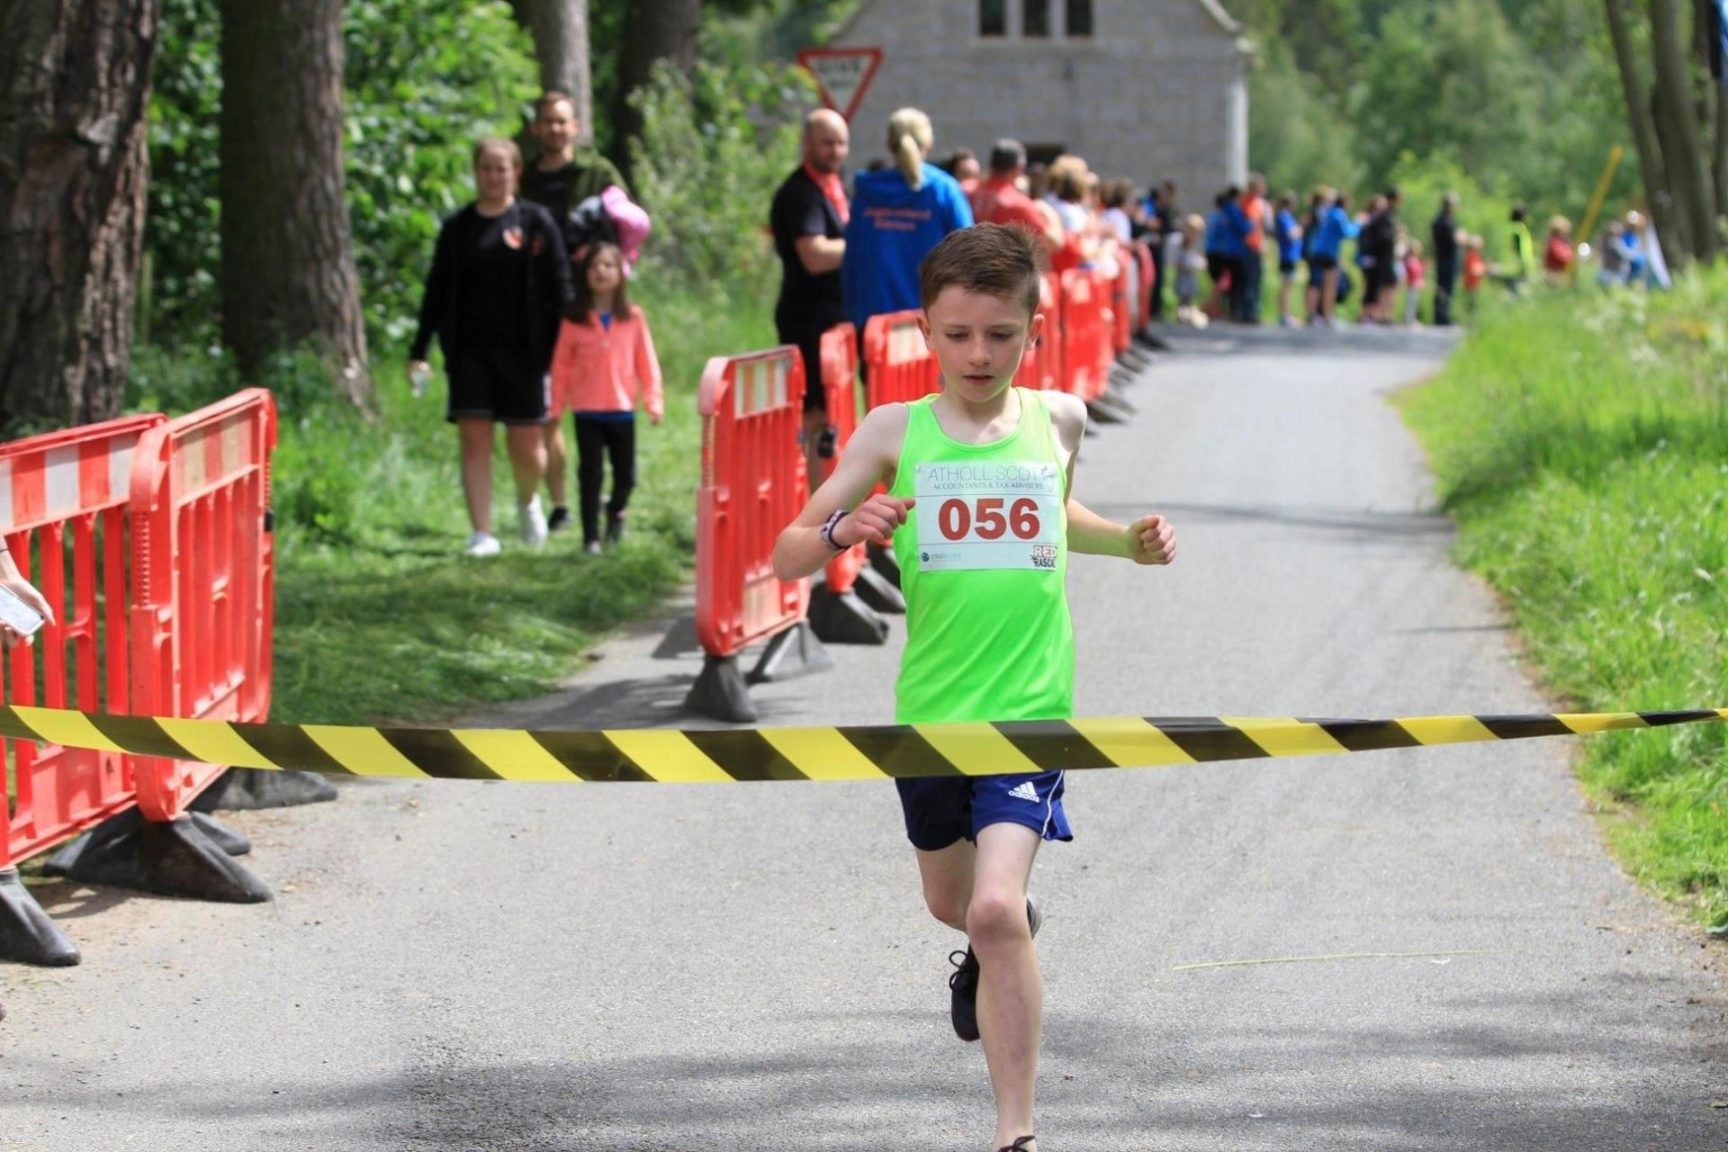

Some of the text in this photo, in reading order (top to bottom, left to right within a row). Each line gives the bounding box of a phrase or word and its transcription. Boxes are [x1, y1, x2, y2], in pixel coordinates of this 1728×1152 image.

[927, 465, 993, 482] ATHOLL
[933, 482, 987, 490] ACCOUNTANTS
[938, 498, 1040, 541] 056
[1033, 545, 1057, 557] RED
